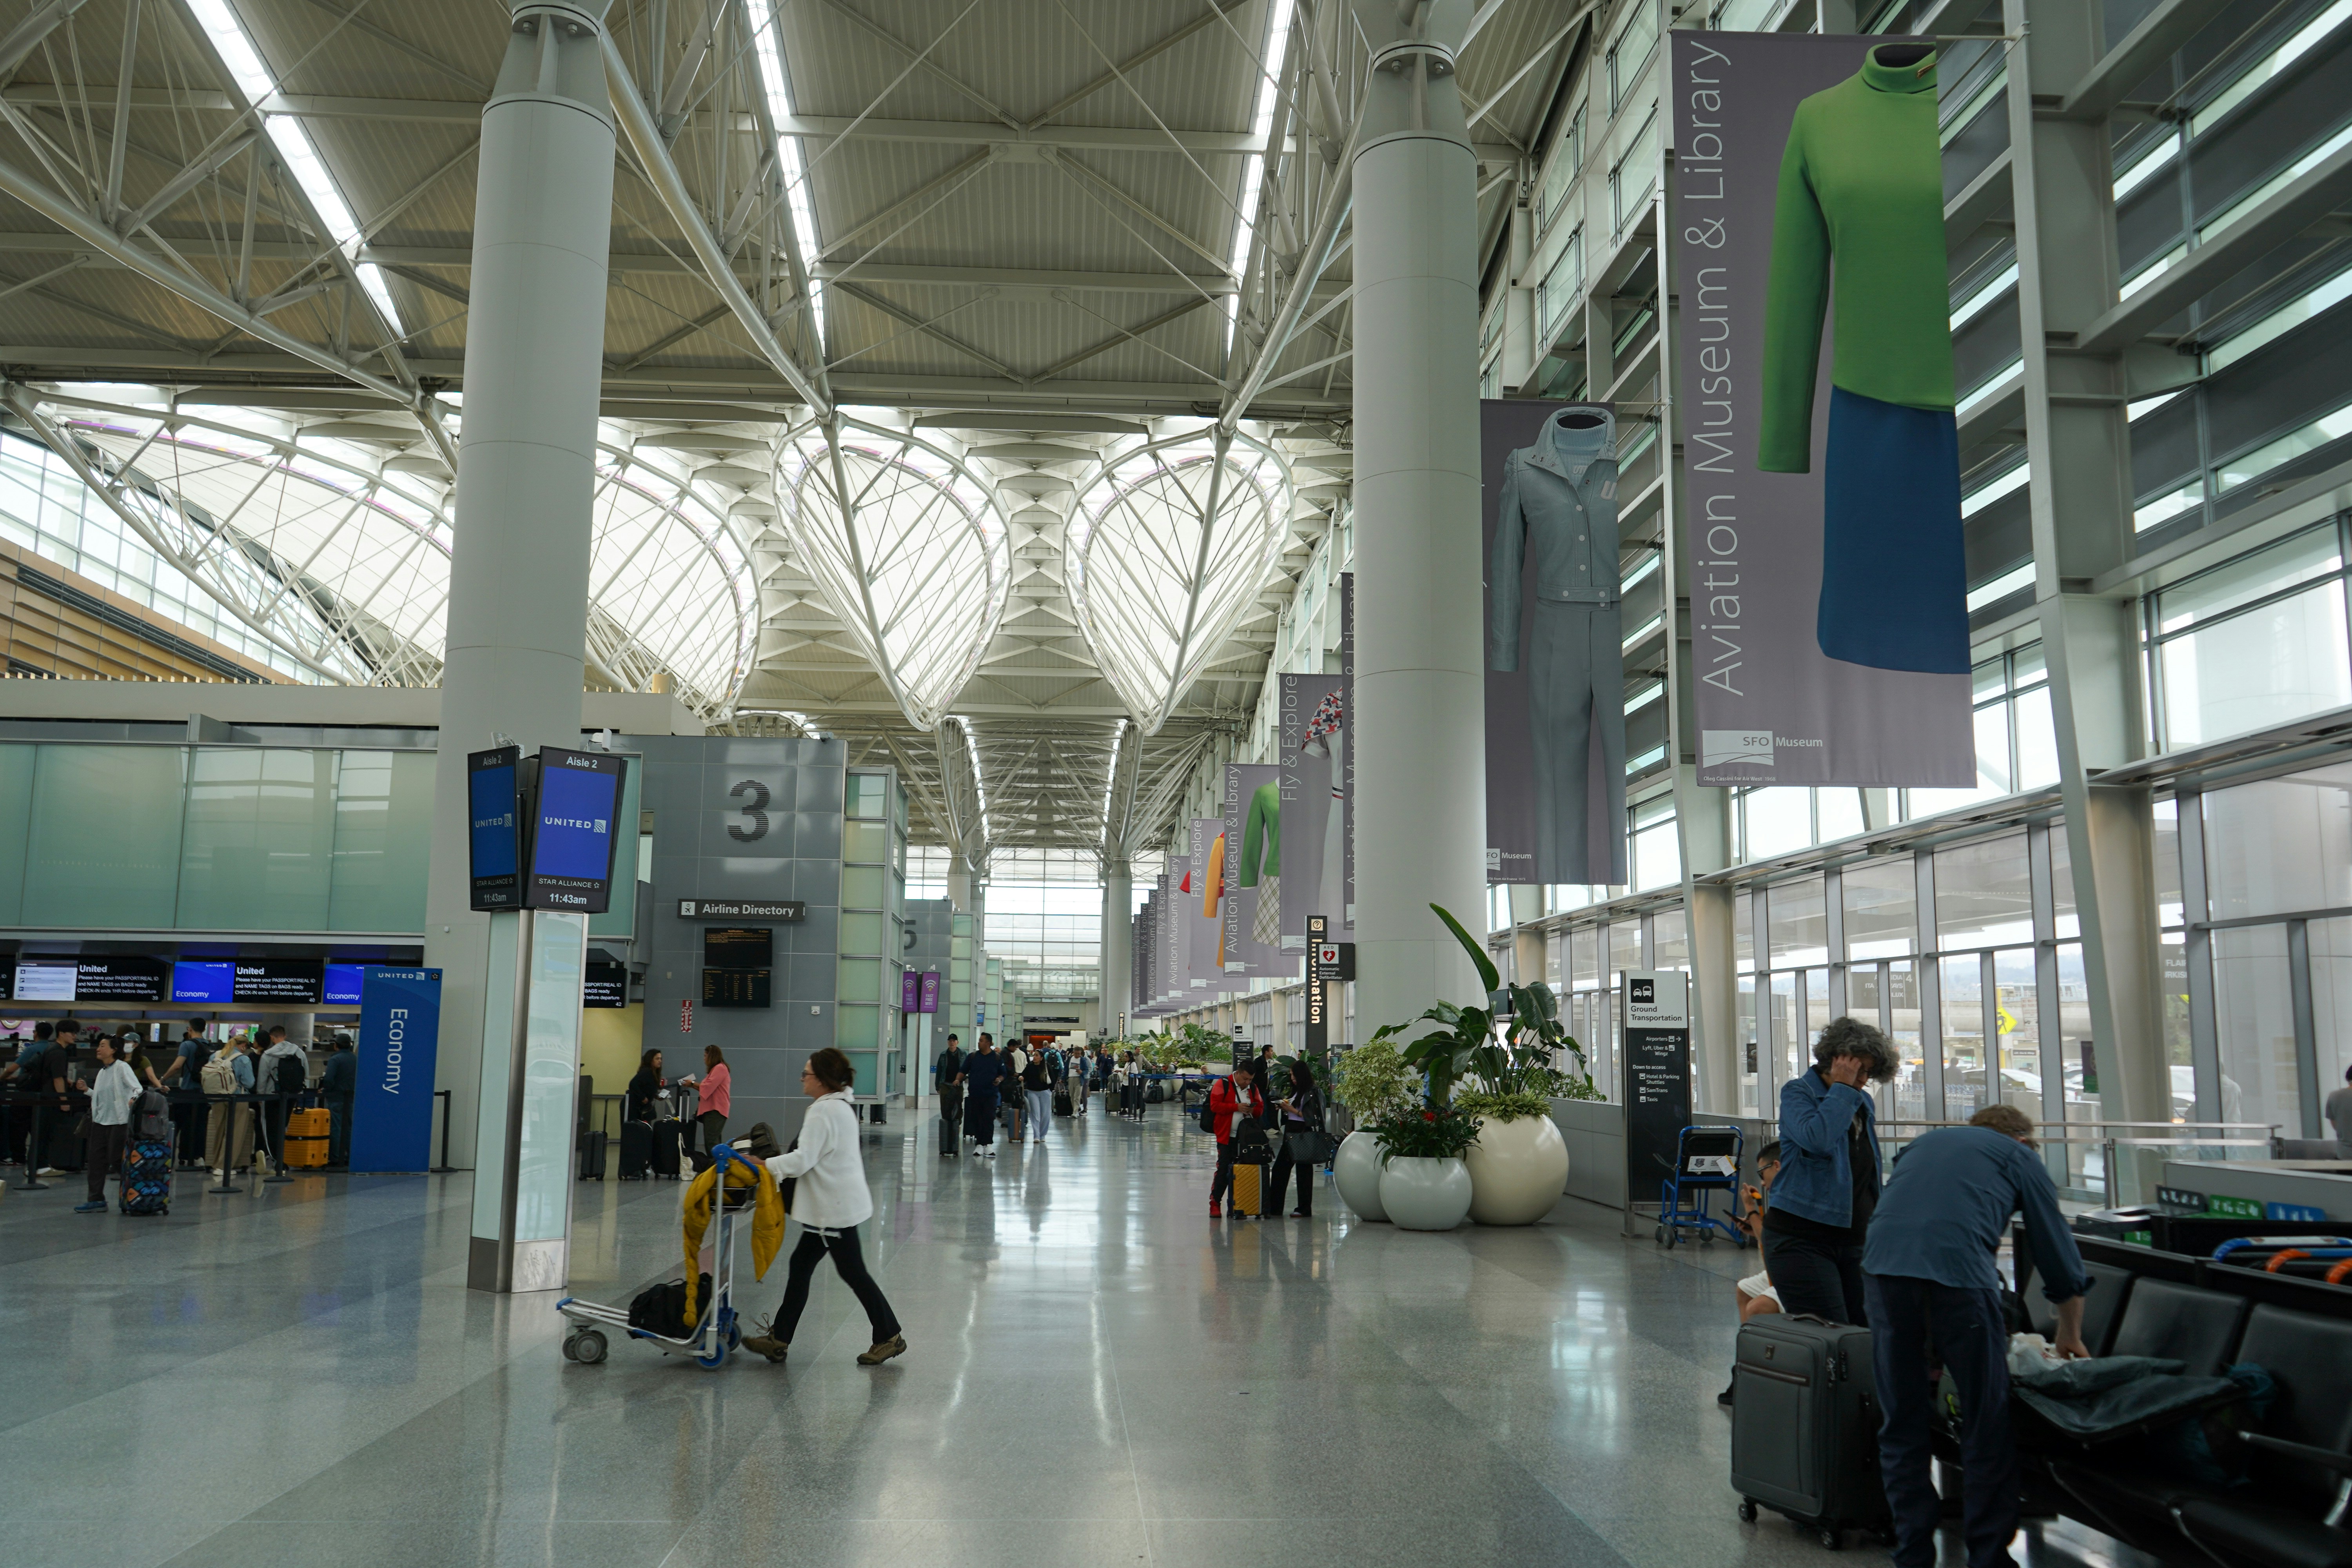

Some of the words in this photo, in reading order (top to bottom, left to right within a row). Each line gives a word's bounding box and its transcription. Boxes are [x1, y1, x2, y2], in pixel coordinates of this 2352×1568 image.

[1681, 40, 1731, 198] Library
[1685, 217, 1725, 249] &
[1692, 267, 1734, 473] Museum
[1697, 495, 1744, 697] Aviation
[1281, 676, 1301, 748] Explore
[1743, 737, 1769, 746] SFO
[1776, 737, 1823, 747] Museum
[483, 756, 496, 766] Aisle
[497, 755, 502, 763] 2
[566, 756, 590, 767] Aisle
[592, 760, 597, 768] 2
[1281, 755, 1297, 767] &
[1226, 766, 1241, 813] Library
[1281, 774, 1301, 800] Fly
[475, 818, 502, 828] UNITED
[544, 817, 592, 829] UNITED
[727, 780, 771, 842] 3
[1226, 817, 1238, 827] &
[1191, 820, 1204, 865] Explore
[1170, 857, 1180, 890] Library
[1192, 868, 1201, 877] &
[1226, 832, 1238, 891] Museum
[558, 880, 592, 888] ALLIANCE
[1158, 876, 1167, 910] Explore
[1191, 880, 1204, 897] Fly
[484, 893, 506, 902] 11:43am
[550, 893, 587, 904] 11:43am
[702, 904, 739, 914] Airline
[742, 905, 794, 917] Directory
[1149, 891, 1157, 918] Library
[1157, 922, 1167, 934] Fly
[1169, 902, 1178, 943] Museum
[1225, 896, 1238, 953] Aviation
[1169, 946, 1178, 985] Aviation
[1906, 974, 1913, 983] 4
[382, 1009, 408, 1094] Economy
